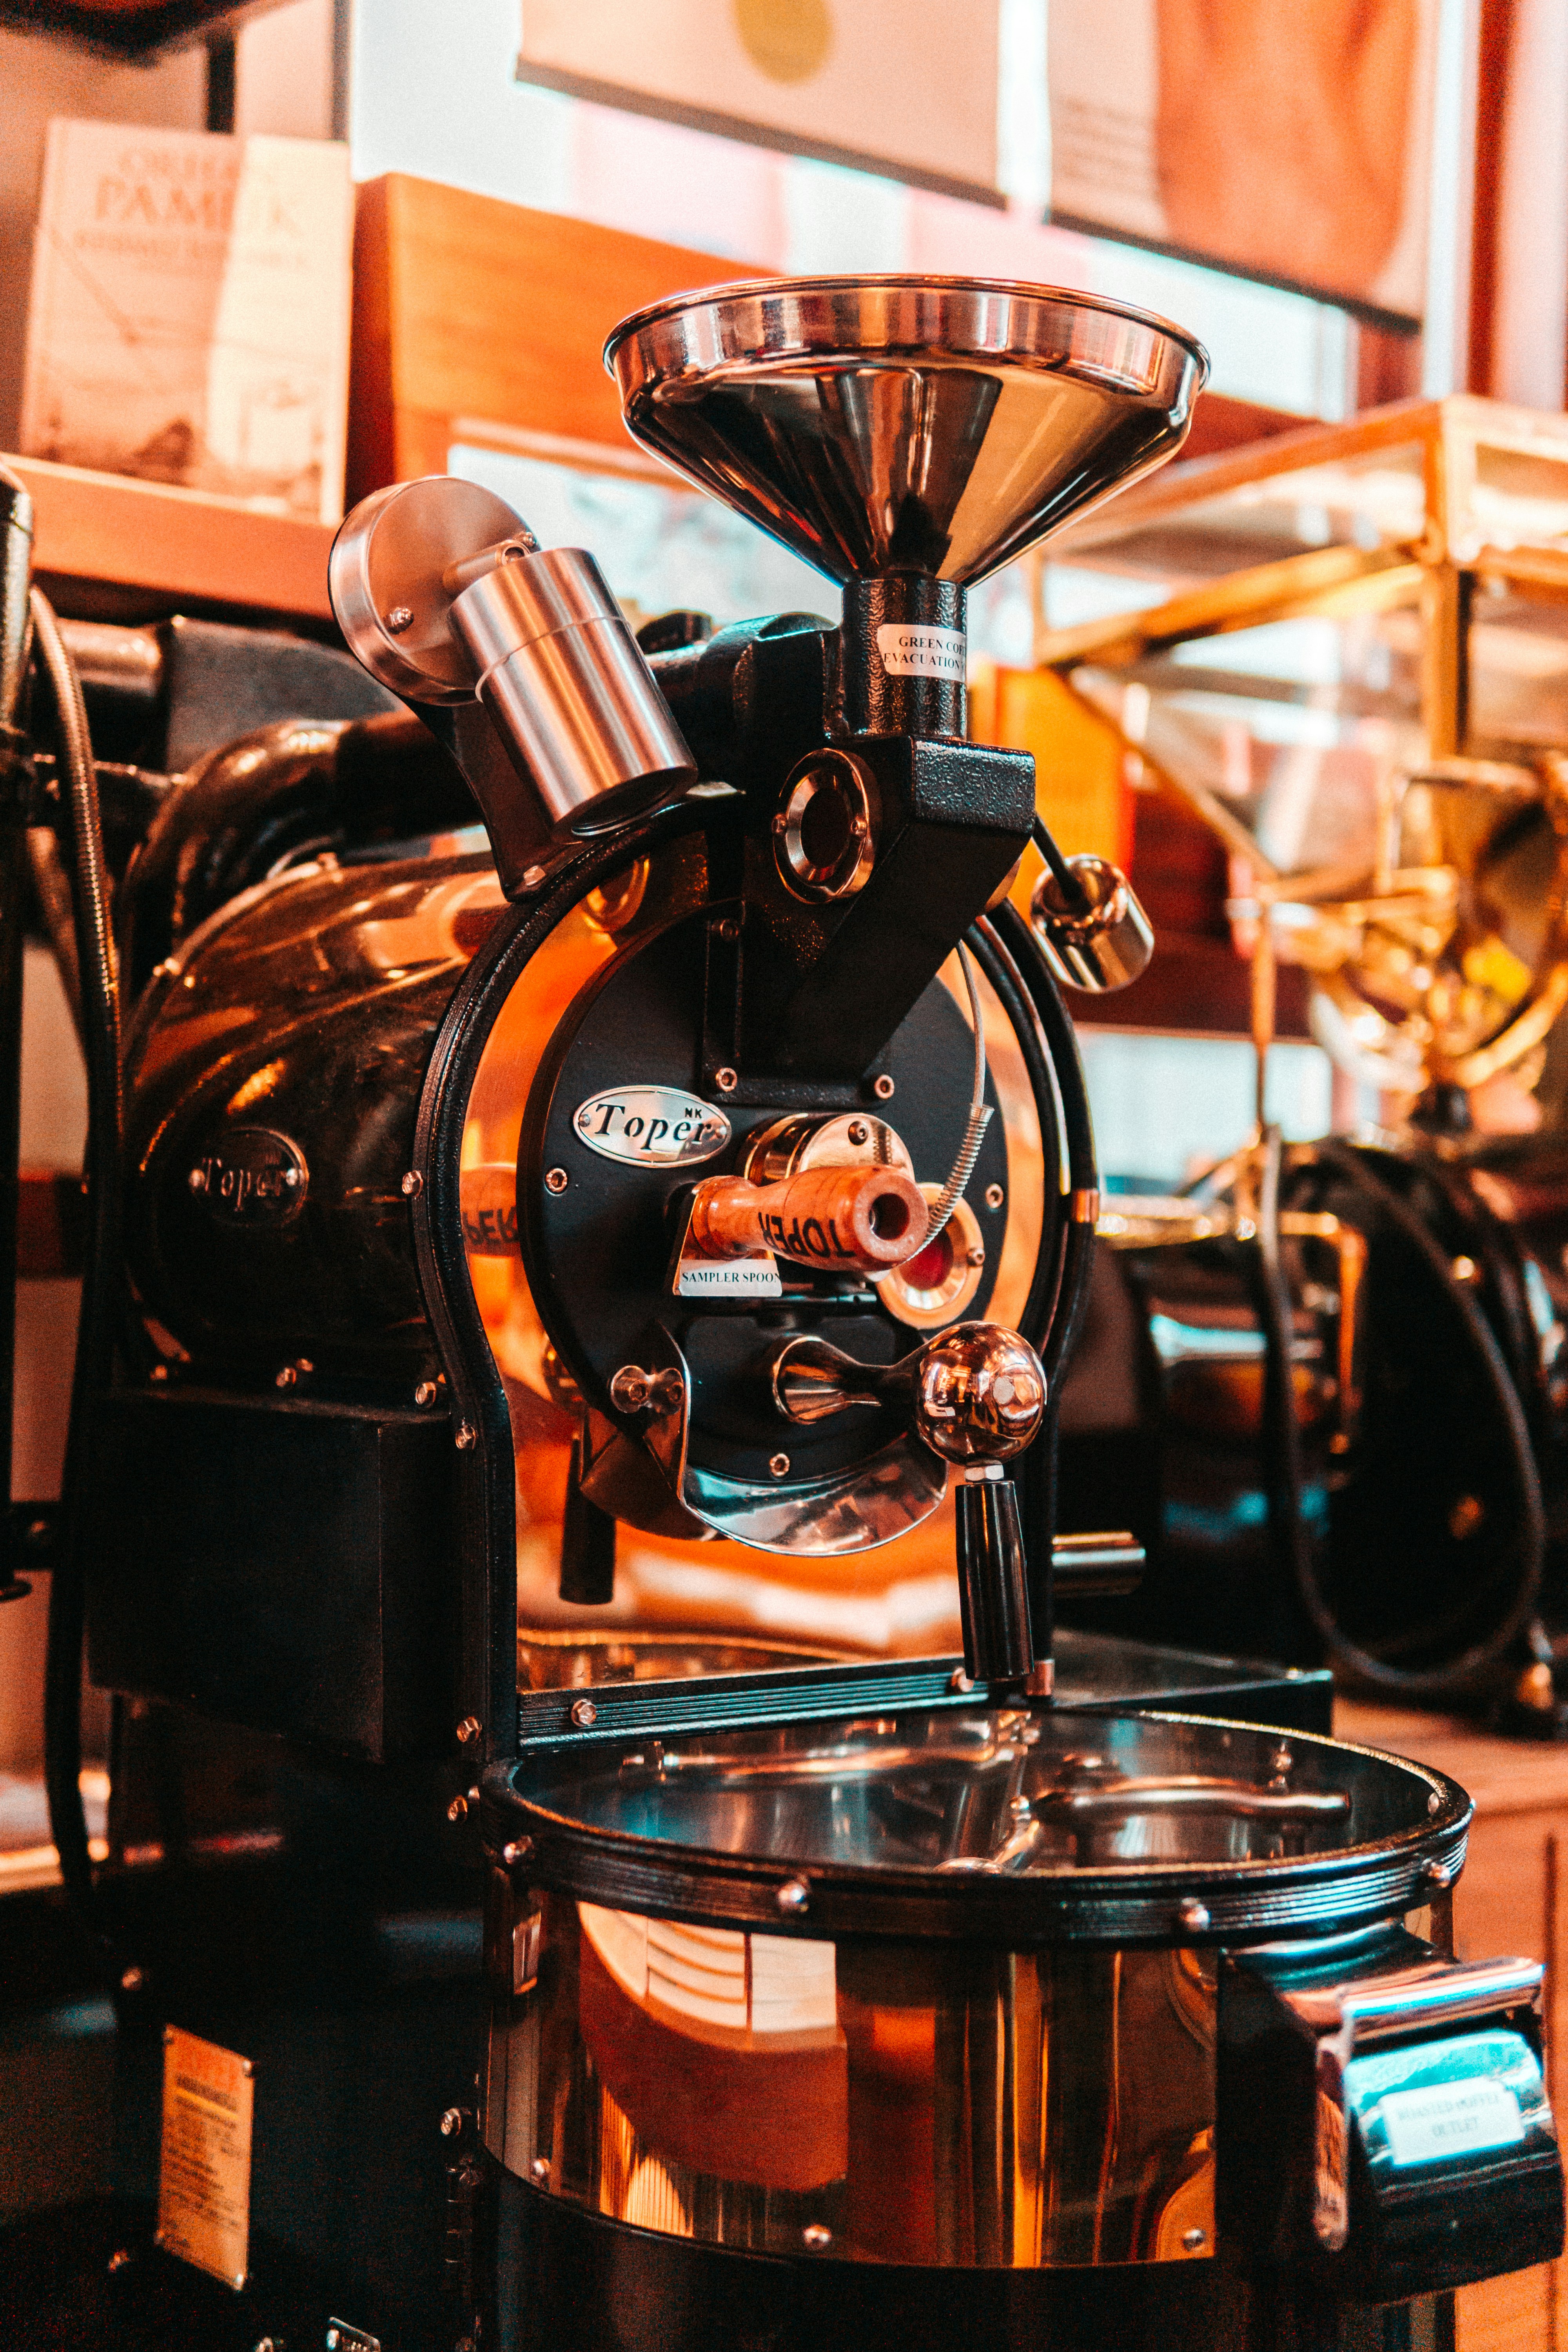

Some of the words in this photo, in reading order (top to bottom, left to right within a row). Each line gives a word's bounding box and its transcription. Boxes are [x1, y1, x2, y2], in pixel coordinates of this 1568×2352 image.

[899, 636, 943, 650] GREEN
[883, 653, 960, 670] EVACUATION
[684, 1107, 702, 1119] NK
[594, 1103, 713, 1151] Toper
[201, 1157, 287, 1212] Toper
[758, 1212, 857, 1258] TOPER
[682, 1272, 740, 1283] SAMPLER
[742, 1272, 780, 1283] SPOON
